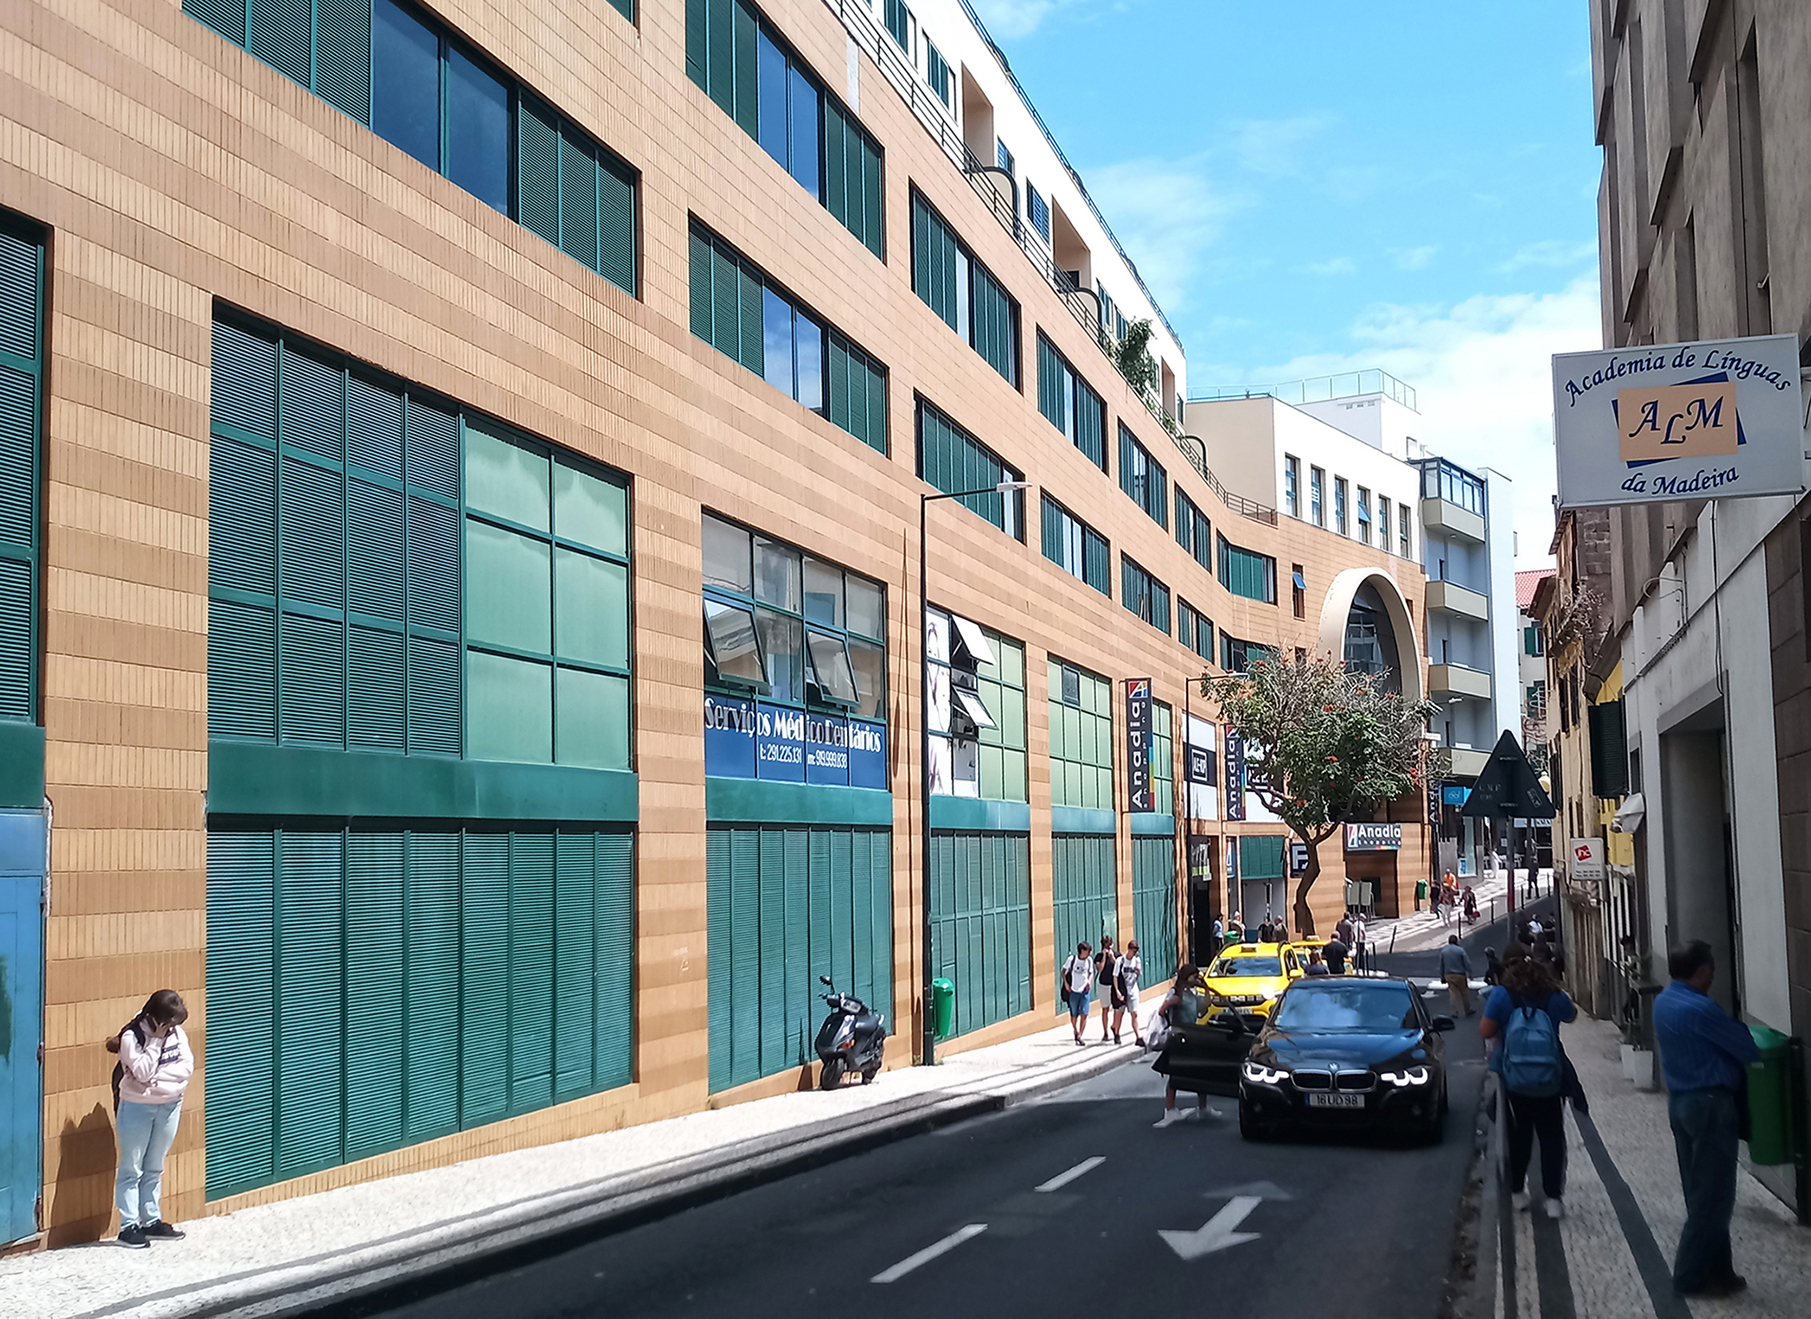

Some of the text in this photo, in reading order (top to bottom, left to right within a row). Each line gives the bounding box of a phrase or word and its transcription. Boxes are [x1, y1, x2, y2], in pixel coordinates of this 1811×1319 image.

[1565, 346, 1791, 407] Academia de Línguas
[1628, 395, 1724, 445] ALM
[1621, 466, 1739, 495] da Madeira
[704, 698, 881, 753] Serviços Médico Dentários
[1130, 702, 1142, 809] Anadia
[1228, 740, 1237, 818] Anadia
[1358, 824, 1401, 838] Anadia
